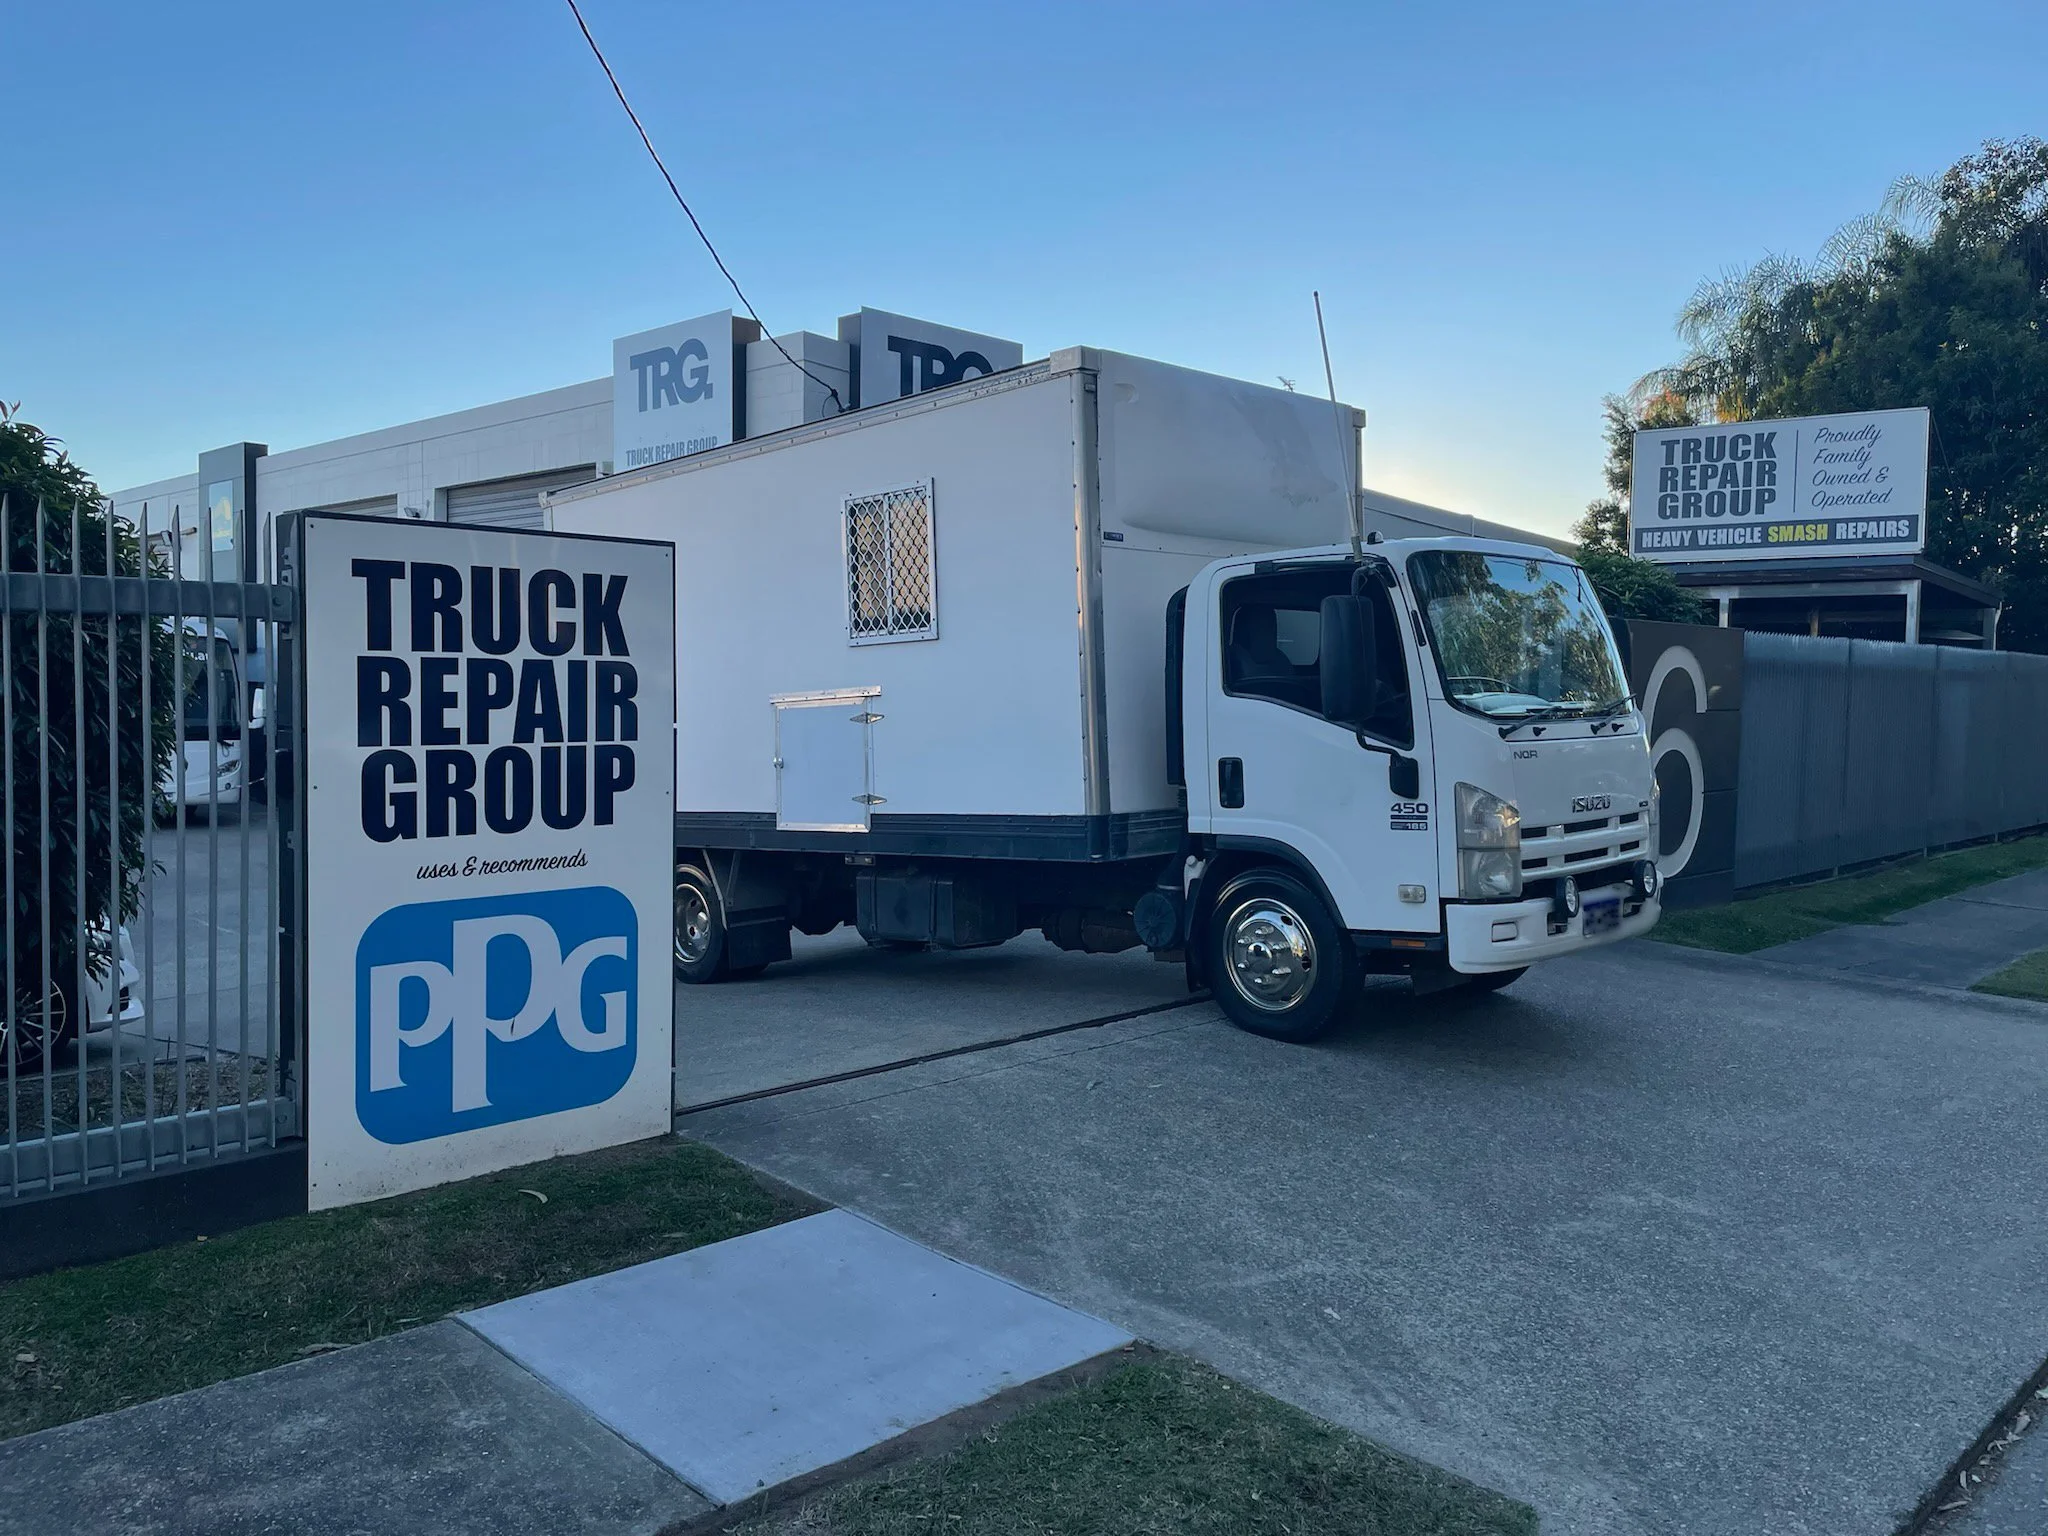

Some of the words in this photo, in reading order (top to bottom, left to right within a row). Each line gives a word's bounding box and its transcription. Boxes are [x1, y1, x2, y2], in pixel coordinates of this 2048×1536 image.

[625, 446, 654, 466] TRUCK
[655, 441, 686, 461] REPAIR
[687, 436, 718, 454] GROUP
[1661, 432, 1777, 466] TRUCK
[1814, 424, 1882, 448] Proudly
[1813, 446, 1872, 470] Family
[1659, 460, 1777, 493] REPAIR
[1812, 467, 1872, 487] Owned
[1875, 466, 1889, 483] &
[1658, 488, 1776, 520] GROUP
[1811, 487, 1893, 511] Operated
[1641, 529, 1693, 548] HEAVY
[1697, 527, 1762, 546] VEHICLE
[1767, 523, 1829, 543] SMASH
[1835, 519, 1910, 540] REPAIRS
[351, 558, 631, 657] TRUCK
[357, 655, 639, 748] REPAIR
[1513, 750, 1538, 759] NQR
[361, 744, 636, 843] GROUP
[1391, 803, 1428, 814] 450
[1572, 793, 1611, 813] ISUZU
[416, 860, 459, 880] uses
[462, 856, 478, 876] &
[479, 848, 588, 876] recommends
[370, 914, 628, 1114] PPG
